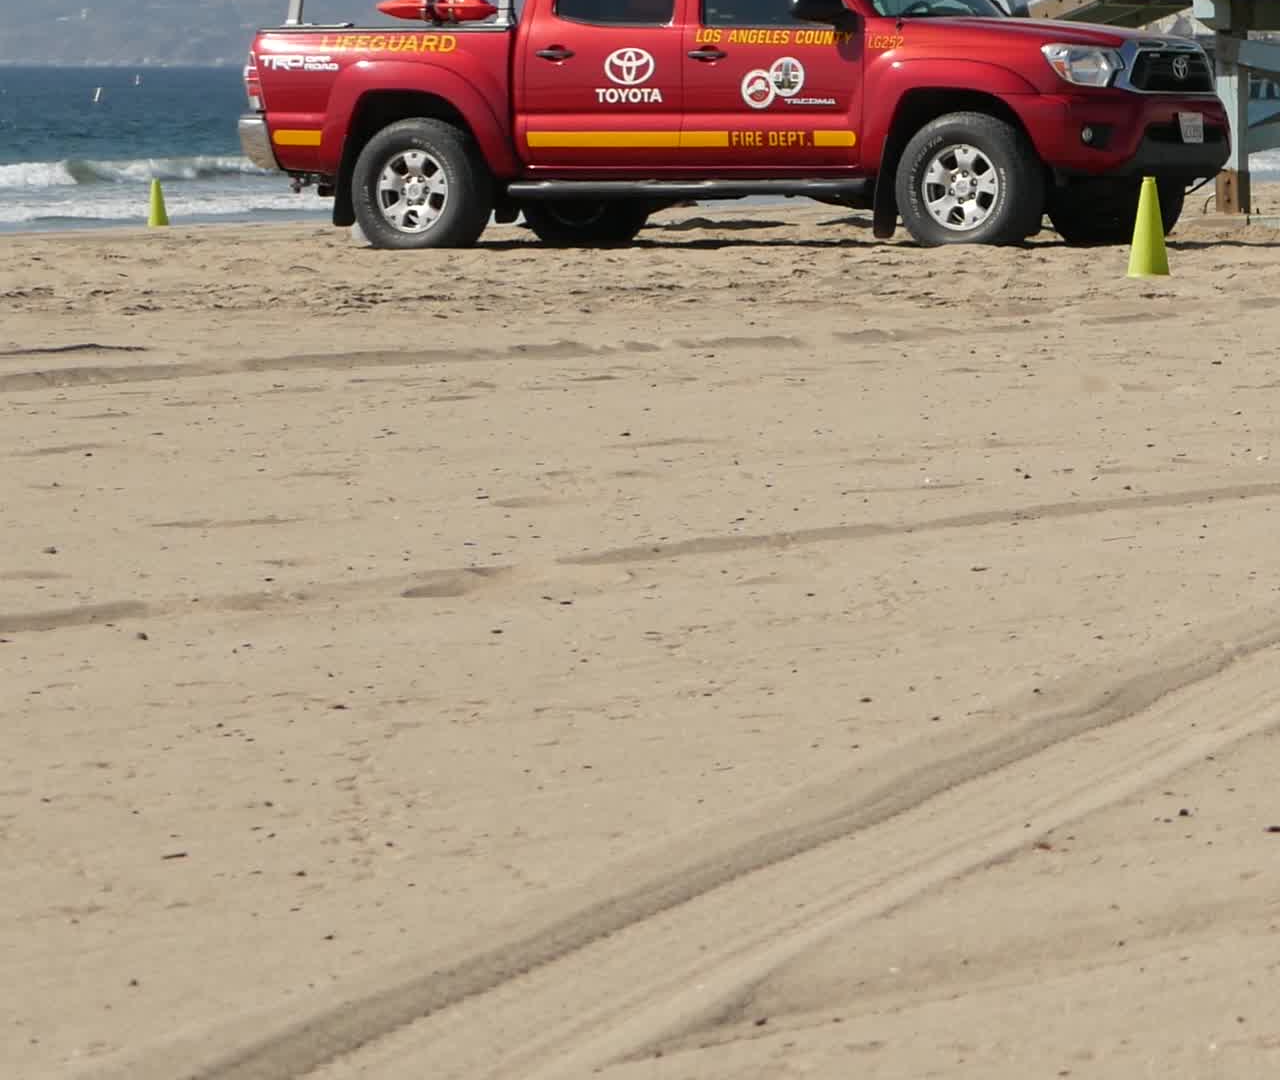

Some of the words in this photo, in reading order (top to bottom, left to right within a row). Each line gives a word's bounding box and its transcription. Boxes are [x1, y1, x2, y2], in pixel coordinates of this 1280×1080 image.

[319, 35, 457, 53] LIFEGUARD
[695, 29, 722, 43] LOS
[728, 30, 790, 45] ANGELES
[795, 30, 853, 46] COUNTY
[868, 34, 904, 49] LG252
[304, 55, 332, 63] OFF
[303, 63, 339, 71] ROAD
[595, 88, 662, 103] TOYOTA
[731, 131, 763, 147] FIRE
[768, 131, 812, 147] DEPT.
